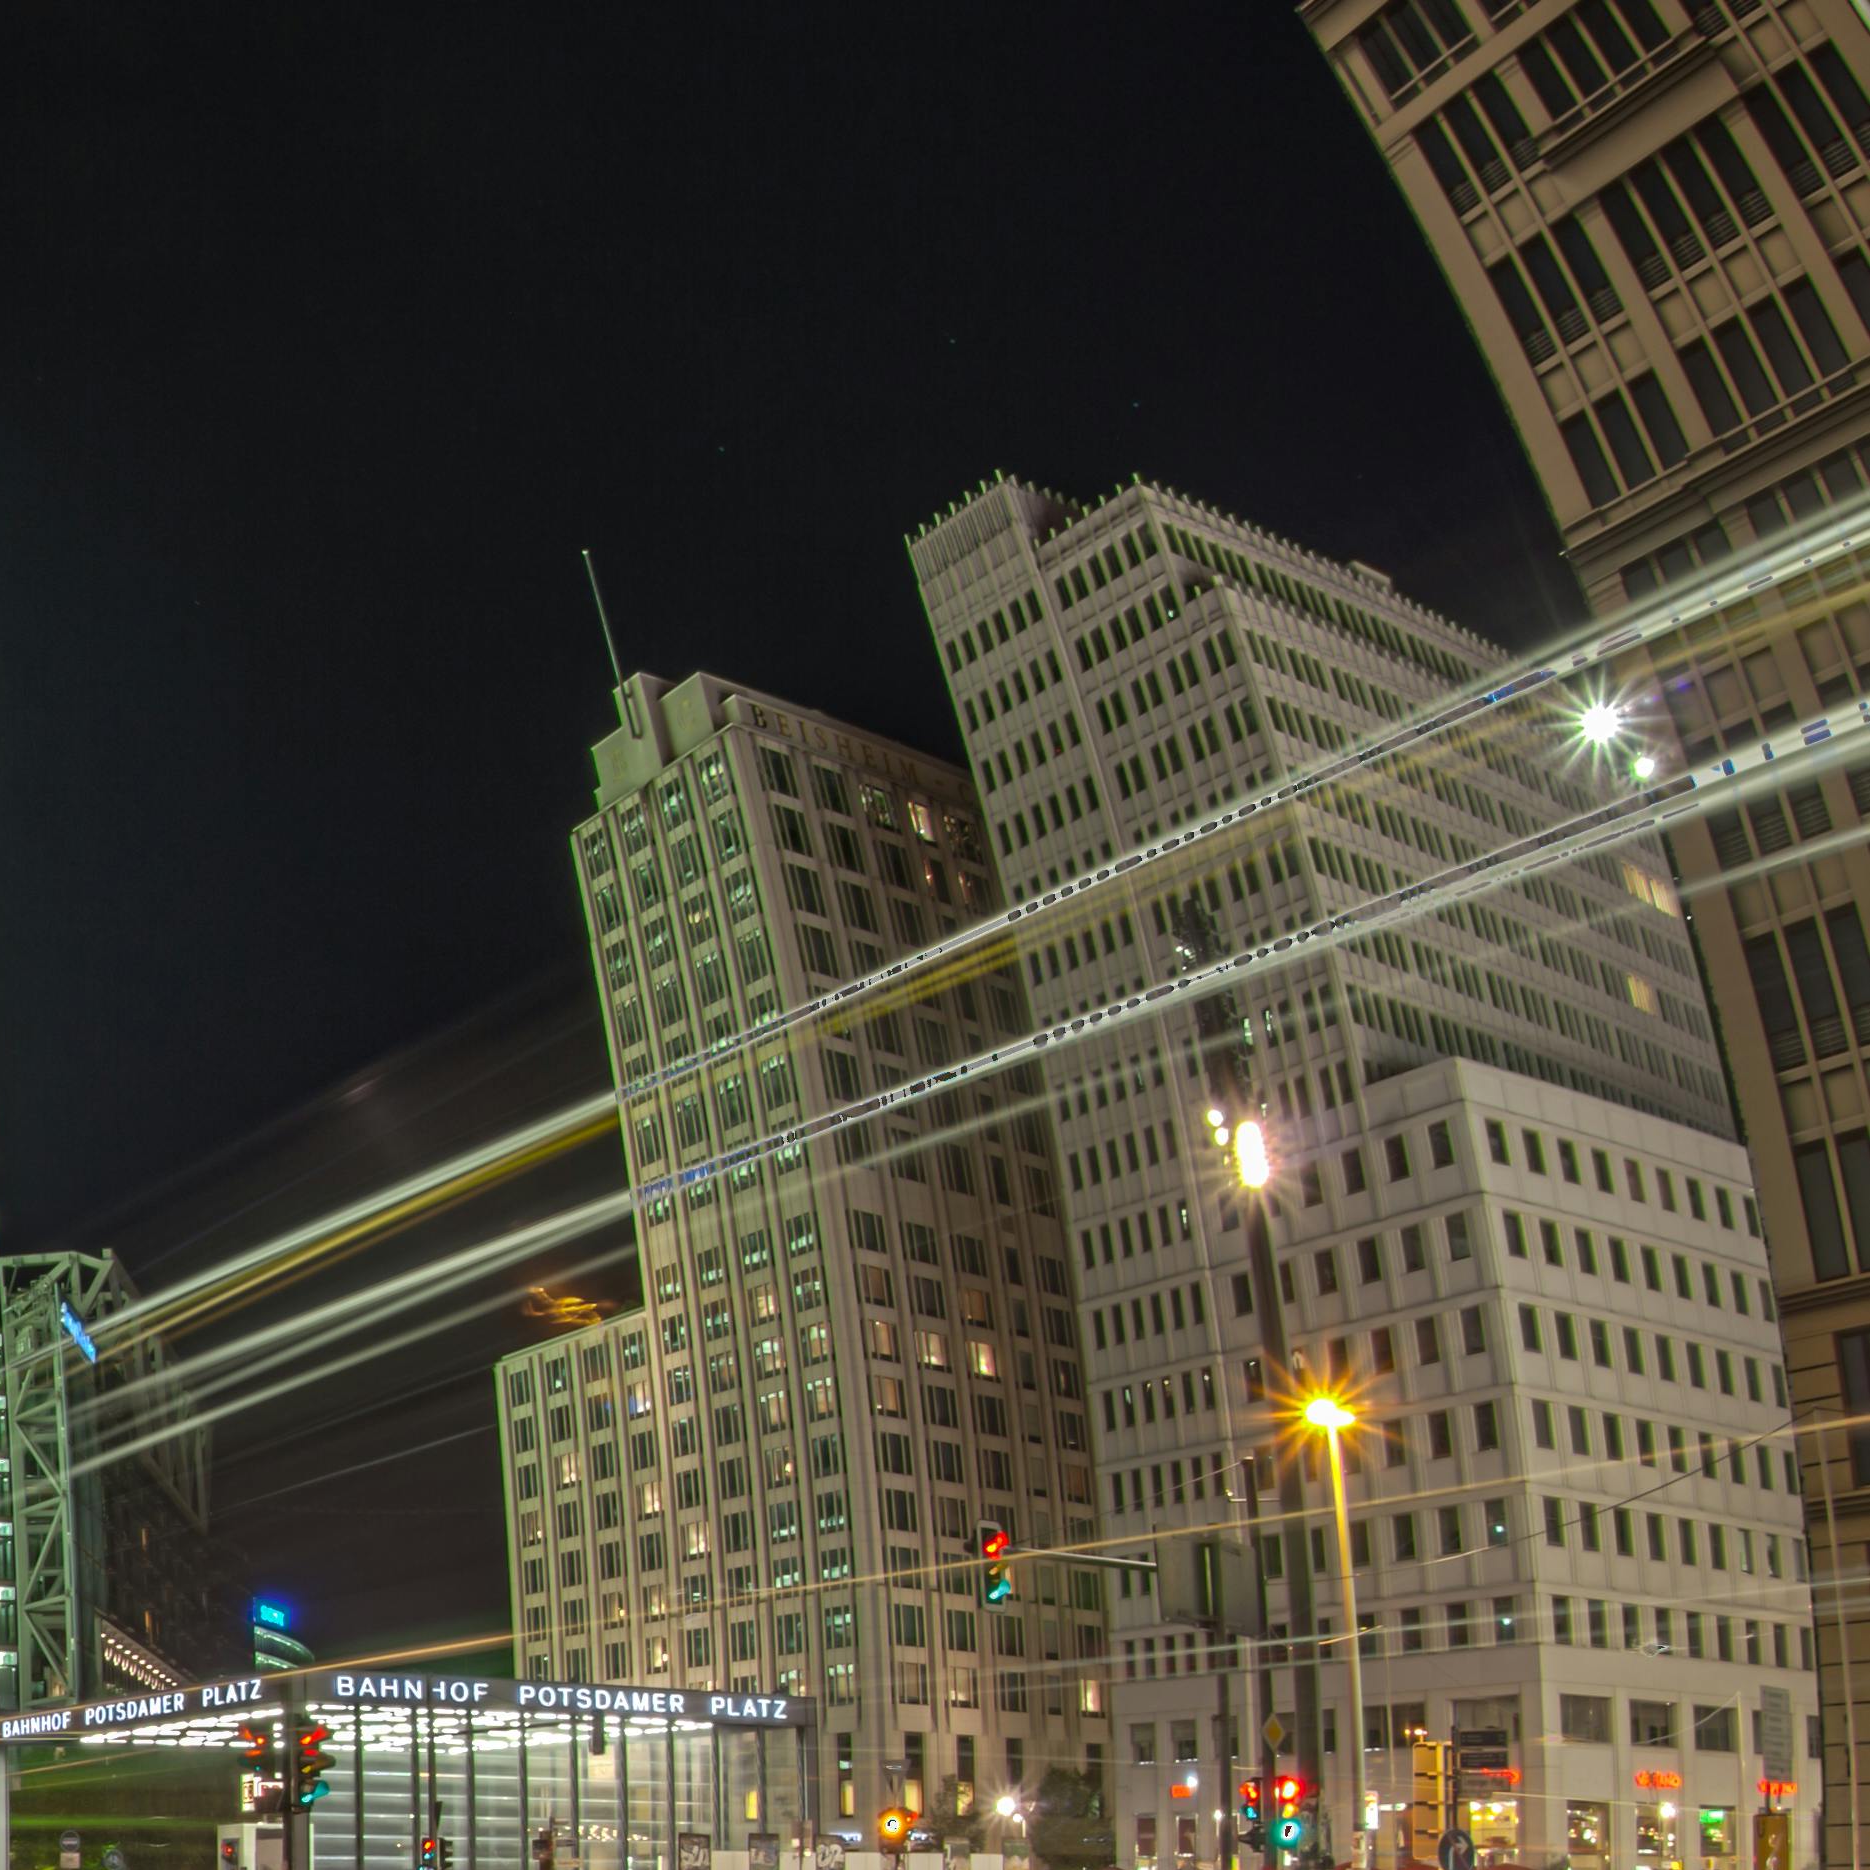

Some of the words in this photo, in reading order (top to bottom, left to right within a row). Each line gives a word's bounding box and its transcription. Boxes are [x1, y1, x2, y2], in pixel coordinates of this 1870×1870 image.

[748, 702, 922, 788] BEISHEIM
[2, 1711, 72, 1739] BAHNHOF
[84, 1692, 185, 1726] POTSDAMER
[202, 1679, 262, 1708] PLATZ
[336, 1675, 489, 1702] BAHNHOF
[518, 1684, 685, 1713] POTSDAMER
[711, 1696, 788, 1720] PLATZ
